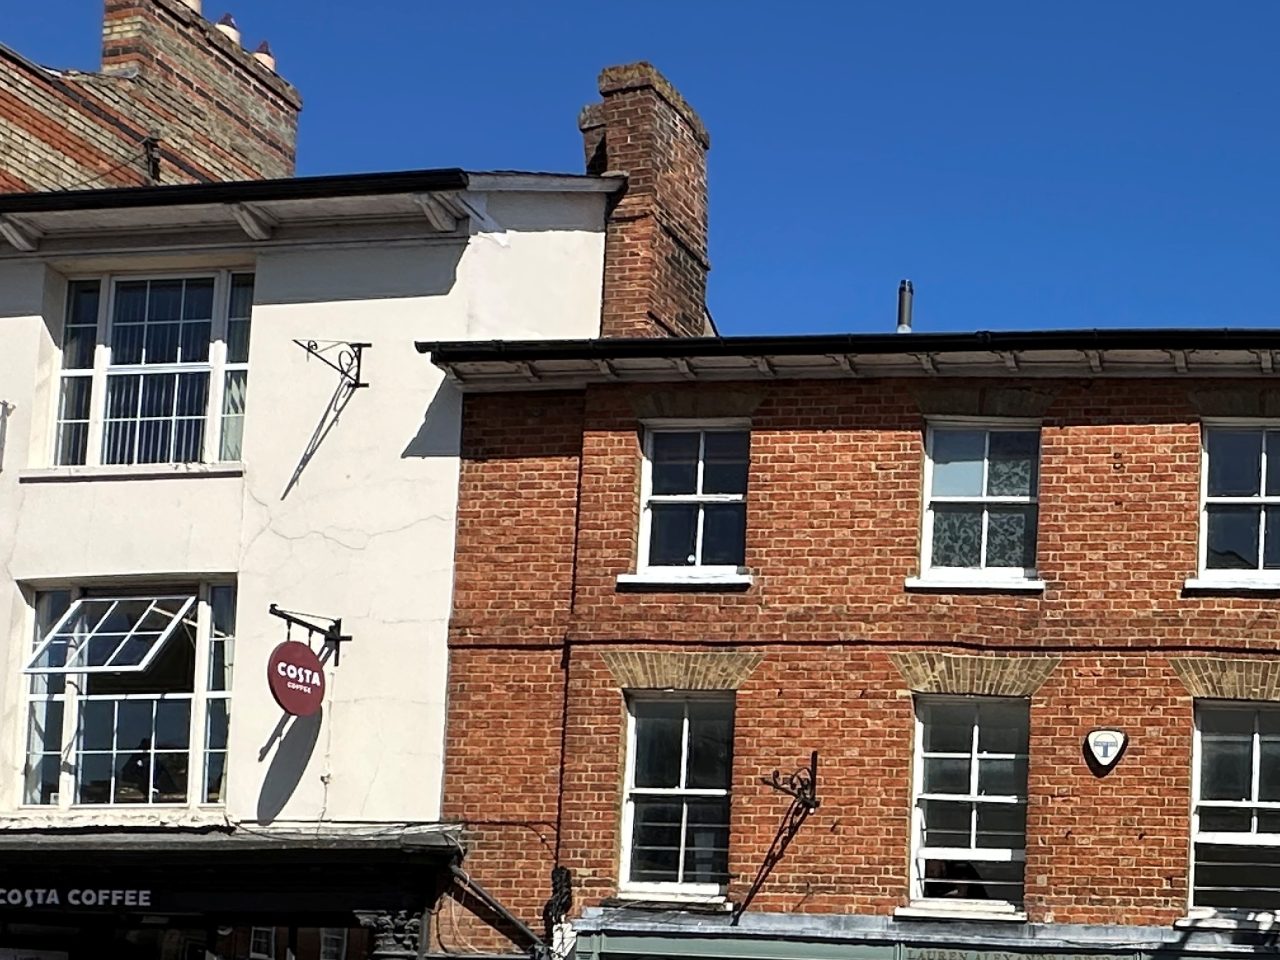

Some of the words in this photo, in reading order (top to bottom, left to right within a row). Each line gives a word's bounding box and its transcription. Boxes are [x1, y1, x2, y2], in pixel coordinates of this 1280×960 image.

[277, 662, 321, 686] COSTA
[286, 681, 312, 695] COFFEE
[0, 888, 60, 907] COSTA
[67, 888, 152, 907] COFFEE
